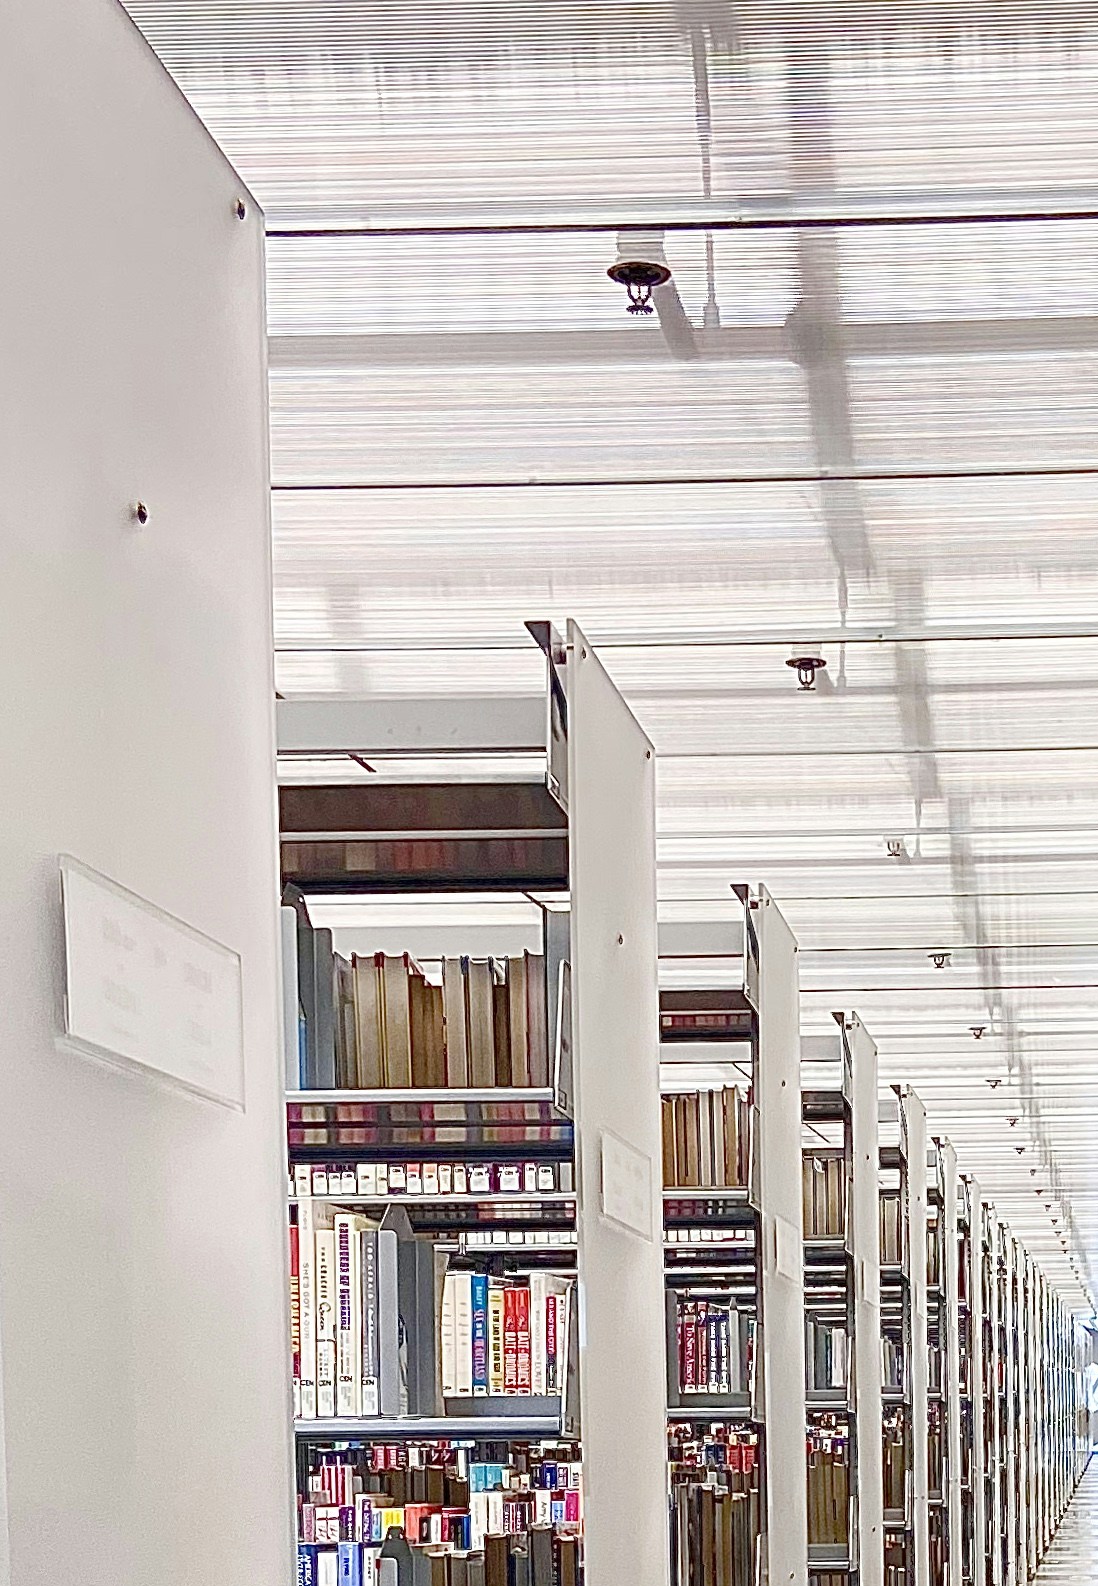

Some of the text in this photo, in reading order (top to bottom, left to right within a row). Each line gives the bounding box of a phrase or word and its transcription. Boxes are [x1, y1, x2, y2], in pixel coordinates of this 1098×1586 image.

[302, 1262, 310, 1288] SHE'S
[302, 1291, 310, 1310] GOT
[319, 1302, 332, 1331] Queen
